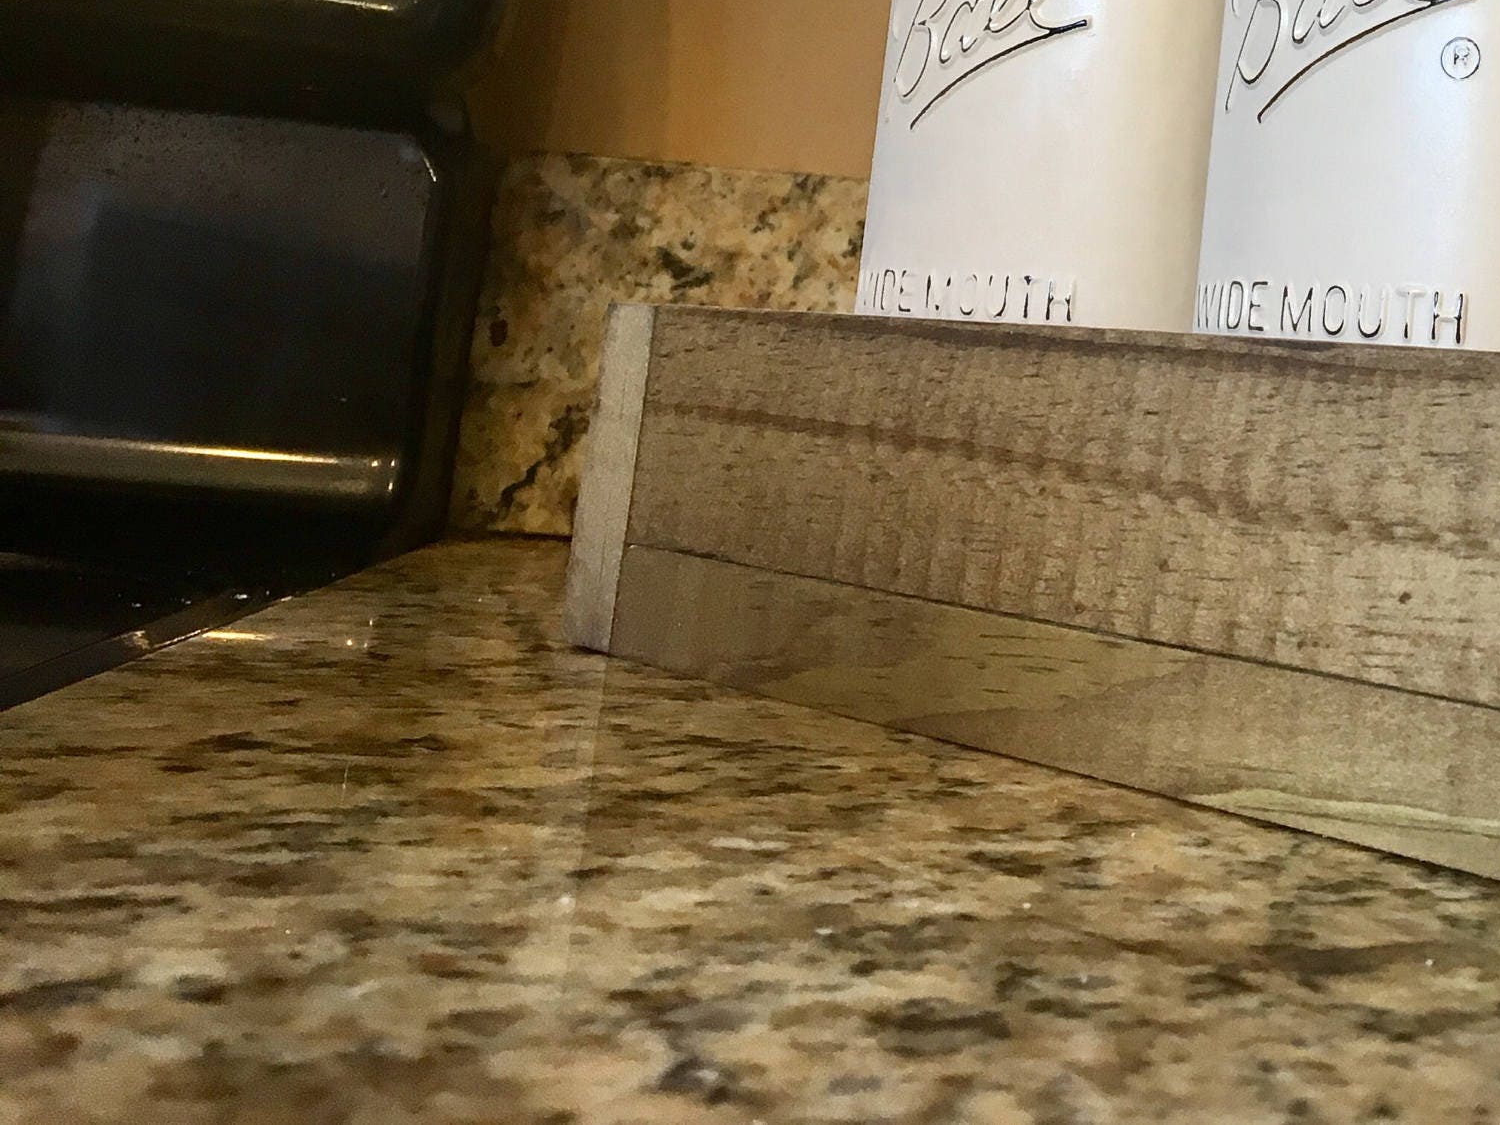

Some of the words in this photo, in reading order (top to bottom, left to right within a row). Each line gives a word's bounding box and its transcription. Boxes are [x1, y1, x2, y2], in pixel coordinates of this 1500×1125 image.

[925, 273, 1075, 321] MOUTH
[1197, 281, 1269, 332] WIDE
[1280, 285, 1465, 344] MOUTH
